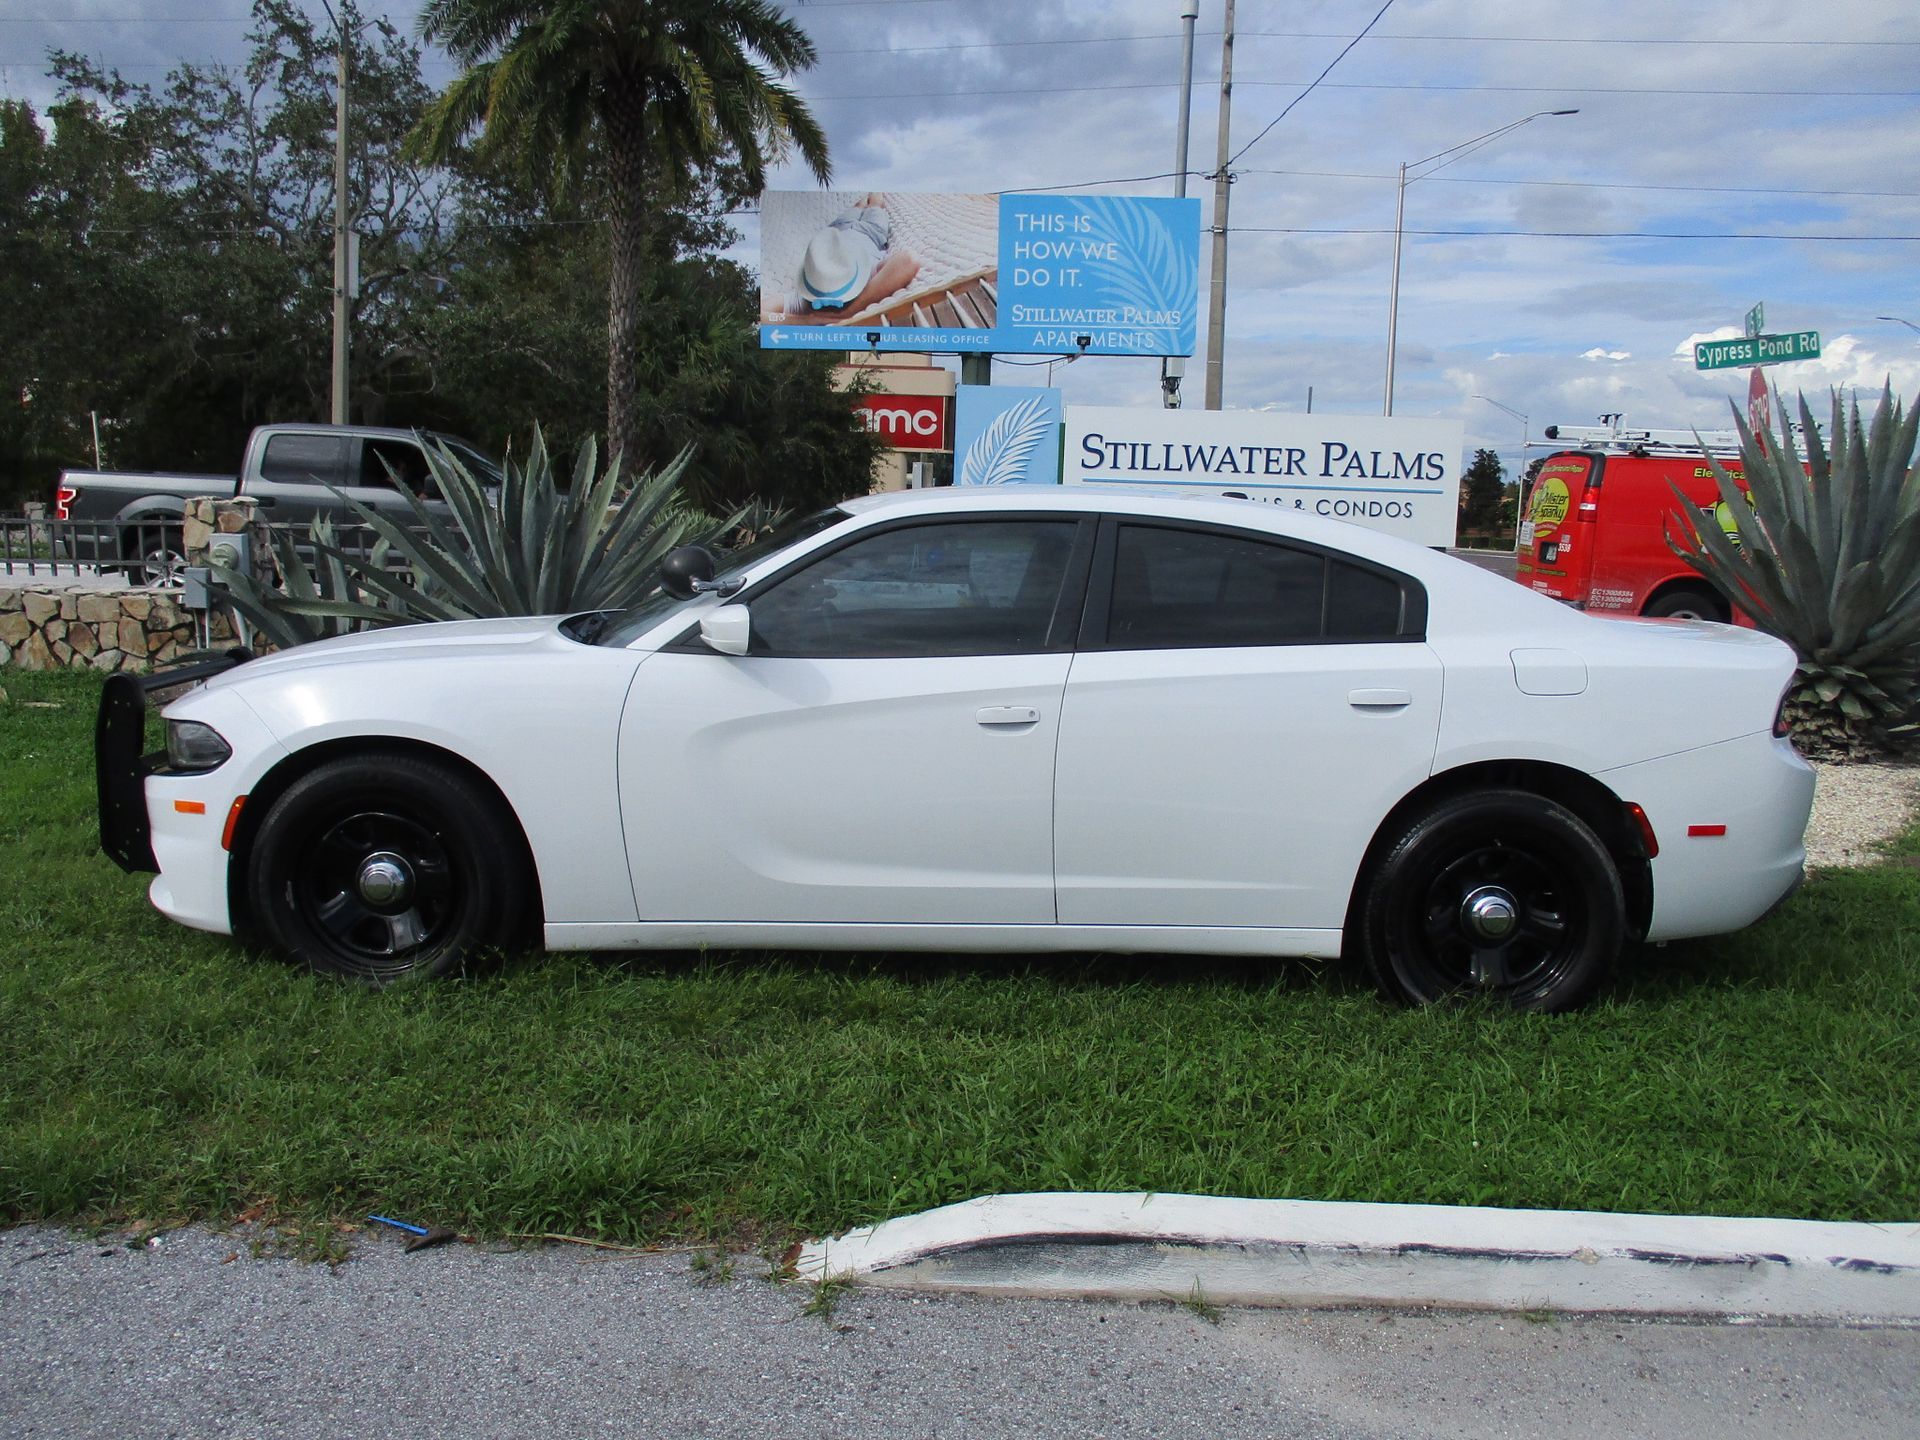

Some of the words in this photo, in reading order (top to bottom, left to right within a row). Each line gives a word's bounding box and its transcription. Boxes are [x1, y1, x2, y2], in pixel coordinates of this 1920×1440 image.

[1014, 213, 1064, 233] THIS
[1074, 214, 1092, 233] IS
[1014, 241, 1074, 260] HOW
[1080, 242, 1118, 261] WE
[1014, 268, 1050, 287] DO
[1059, 268, 1083, 287] IT.
[1012, 304, 1117, 324] STILLWATER
[1122, 306, 1182, 325] PALMS
[792, 332, 823, 342] TURN
[827, 333, 850, 342] LEFT
[855, 333, 868, 343] TO
[877, 333, 898, 343] UR
[902, 334, 948, 344] LEASING
[951, 335, 990, 345] OFFICE
[1696, 343, 1752, 368] Cypress
[1758, 336, 1793, 358] Pond
[1799, 333, 1818, 352] Rd
[1080, 432, 1308, 477] STILLWATER
[1318, 441, 1445, 481] PALMS
[1315, 499, 1414, 519] CONDOS
